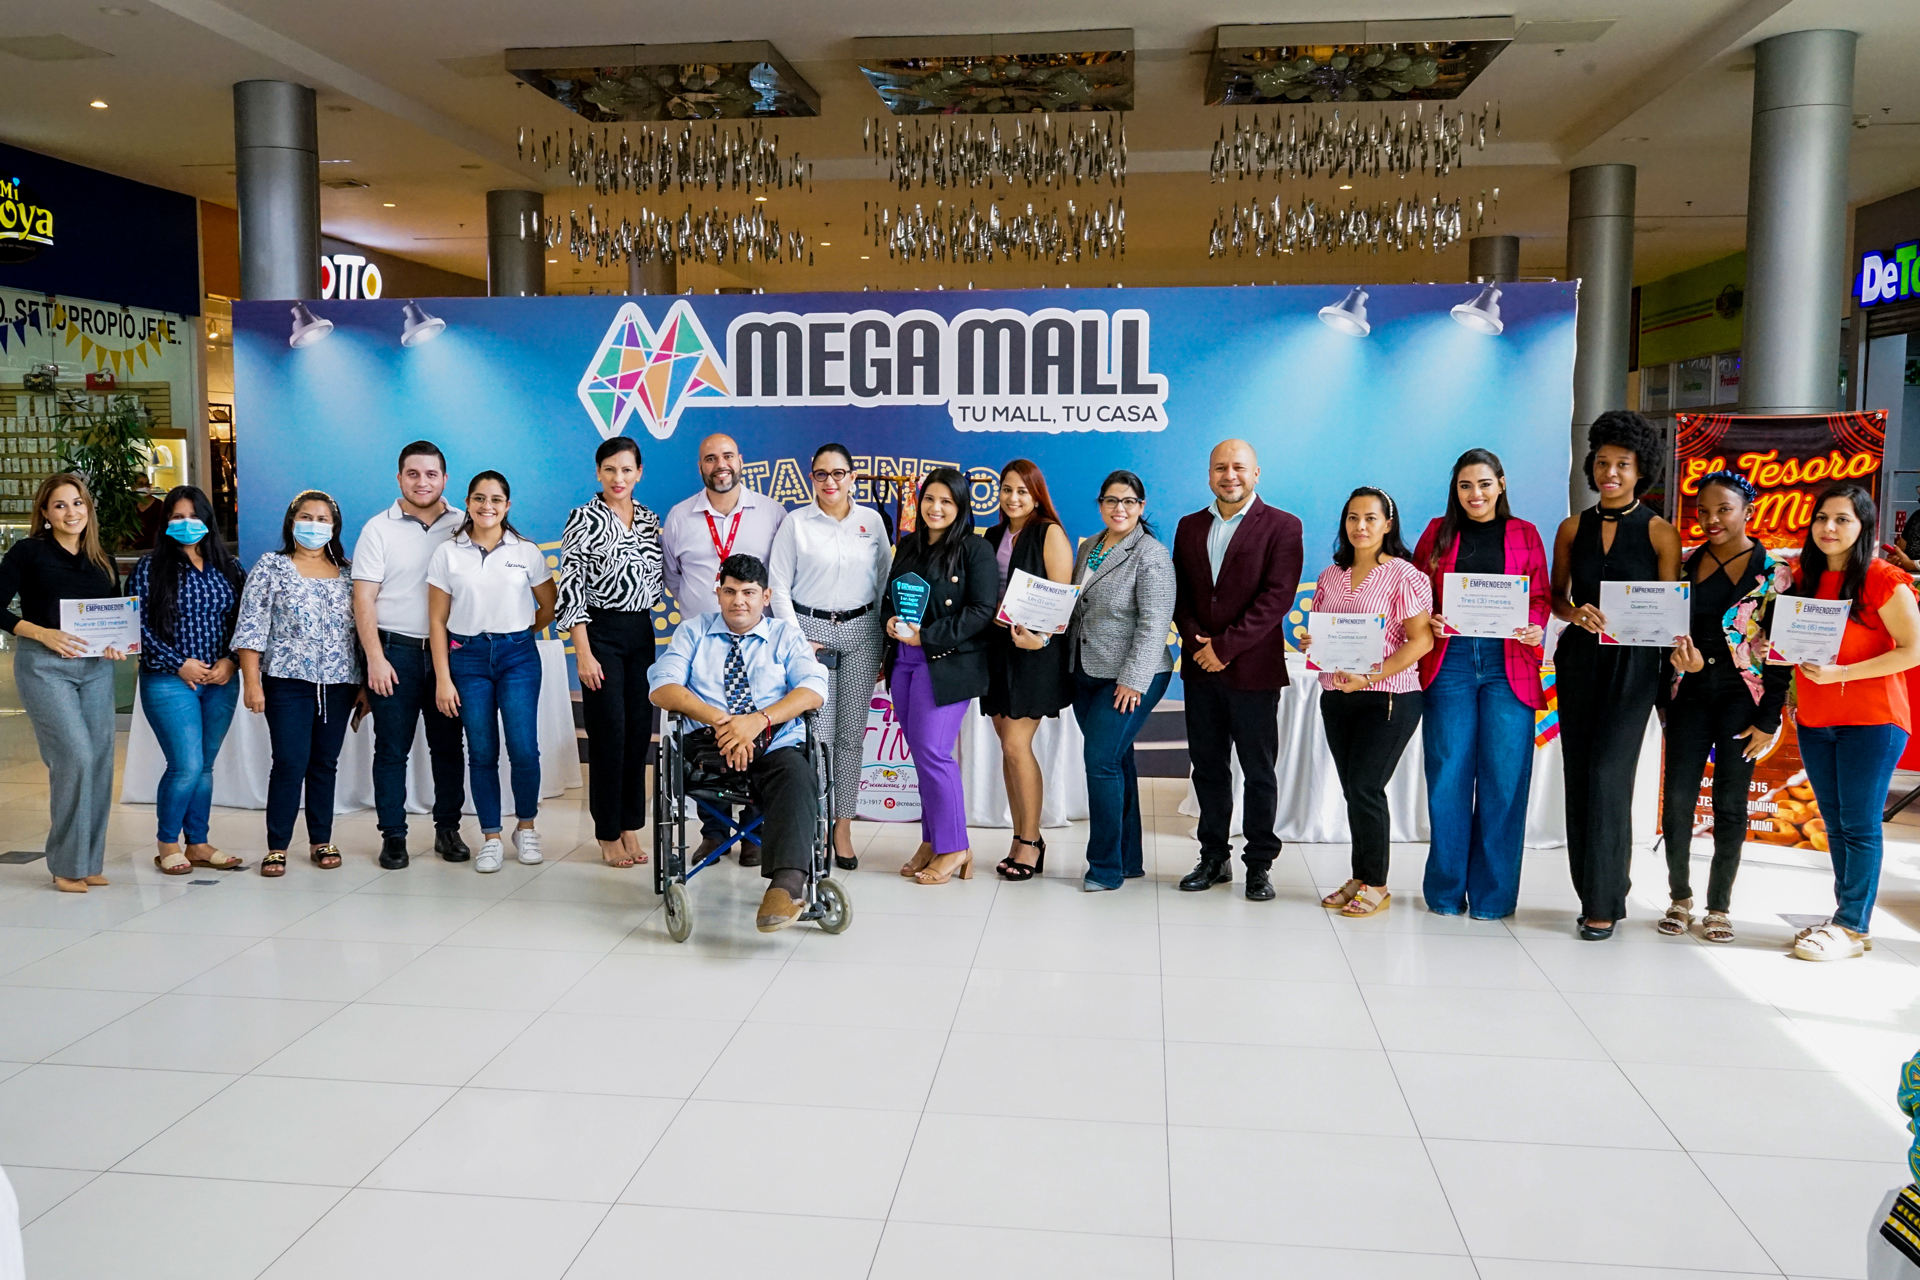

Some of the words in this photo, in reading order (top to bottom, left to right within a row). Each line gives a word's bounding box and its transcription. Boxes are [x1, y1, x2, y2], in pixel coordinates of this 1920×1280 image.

[69, 305, 136, 339] PROPIO
[736, 319, 940, 398] MEGA
[958, 318, 1158, 396] MALL
[958, 406, 986, 422] TU
[992, 406, 1057, 425] MALL,
[1062, 406, 1091, 422] TU
[1096, 405, 1158, 422] CASA
[1738, 450, 1880, 487] Tesoro
[1033, 582, 1068, 595] EMPRENDEDOR
[1470, 580, 1512, 589] EMPRENDEDOR
[1476, 597, 1487, 605] (3)
[86, 603, 125, 612] EMPRENDEDOR
[1803, 604, 1842, 615] EMPRENDEDOR
[1791, 621, 1806, 630] Seis
[1751, 820, 1773, 832] MIMI
